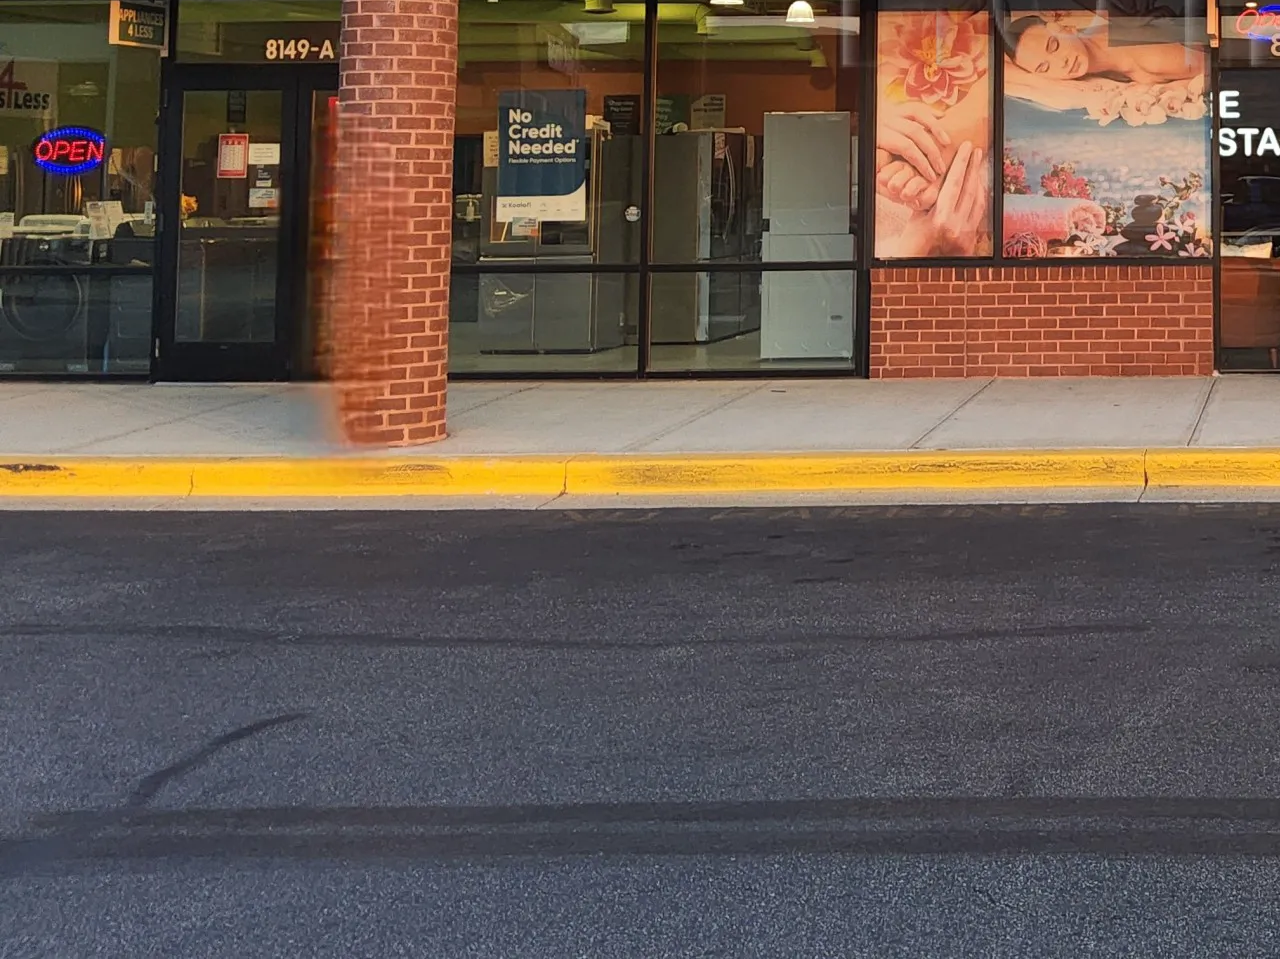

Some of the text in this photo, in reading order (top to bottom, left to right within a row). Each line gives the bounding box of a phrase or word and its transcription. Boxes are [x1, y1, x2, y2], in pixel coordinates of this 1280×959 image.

[119, 8, 164, 26] APPLIANCES
[128, 23, 153, 39] 4 LESS
[265, 39, 335, 60] 8149-A
[509, 109, 532, 123] No
[509, 124, 563, 139] Credit
[35, 140, 106, 161] OPEN
[530, 157, 553, 165] Payment
